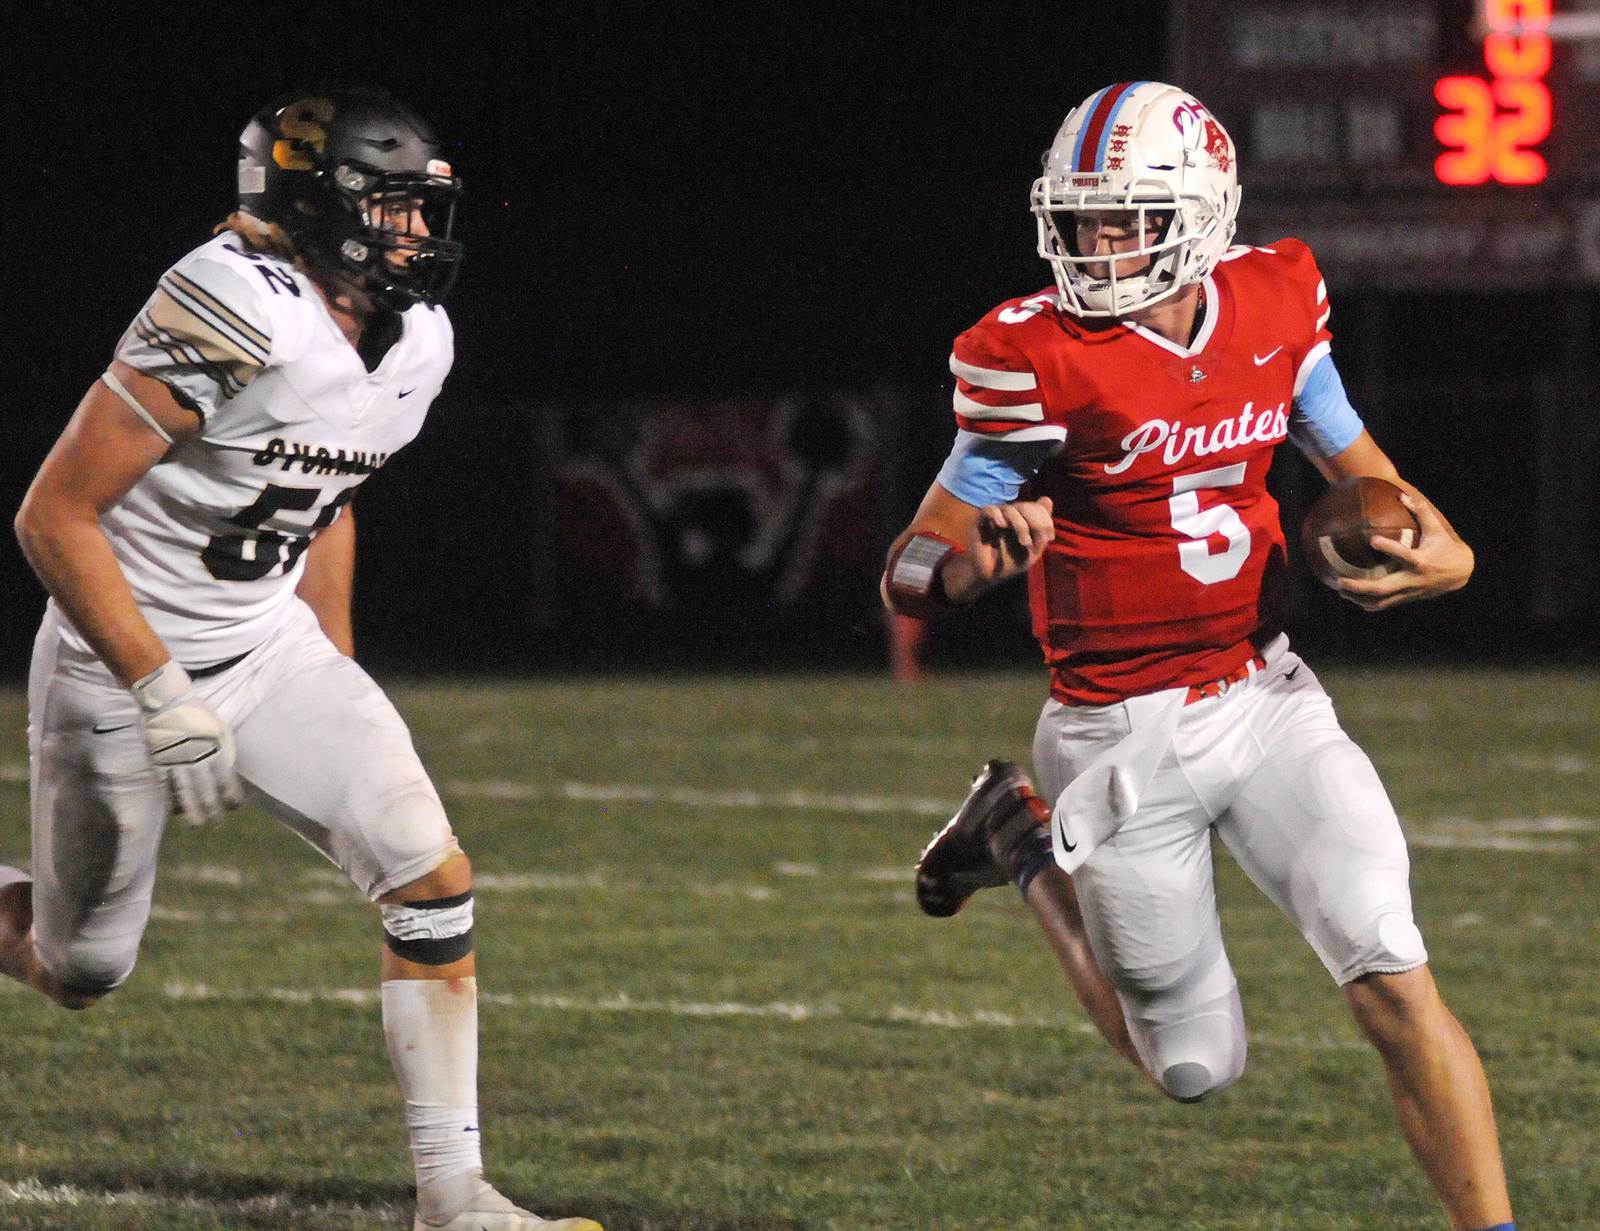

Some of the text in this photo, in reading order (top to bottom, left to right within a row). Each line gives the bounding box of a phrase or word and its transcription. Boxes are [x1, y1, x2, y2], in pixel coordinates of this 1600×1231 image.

[273, 98, 336, 171] S
[1434, 75, 1553, 185] 32
[1103, 401, 1289, 476] Pirates
[1168, 461, 1252, 586] 5
